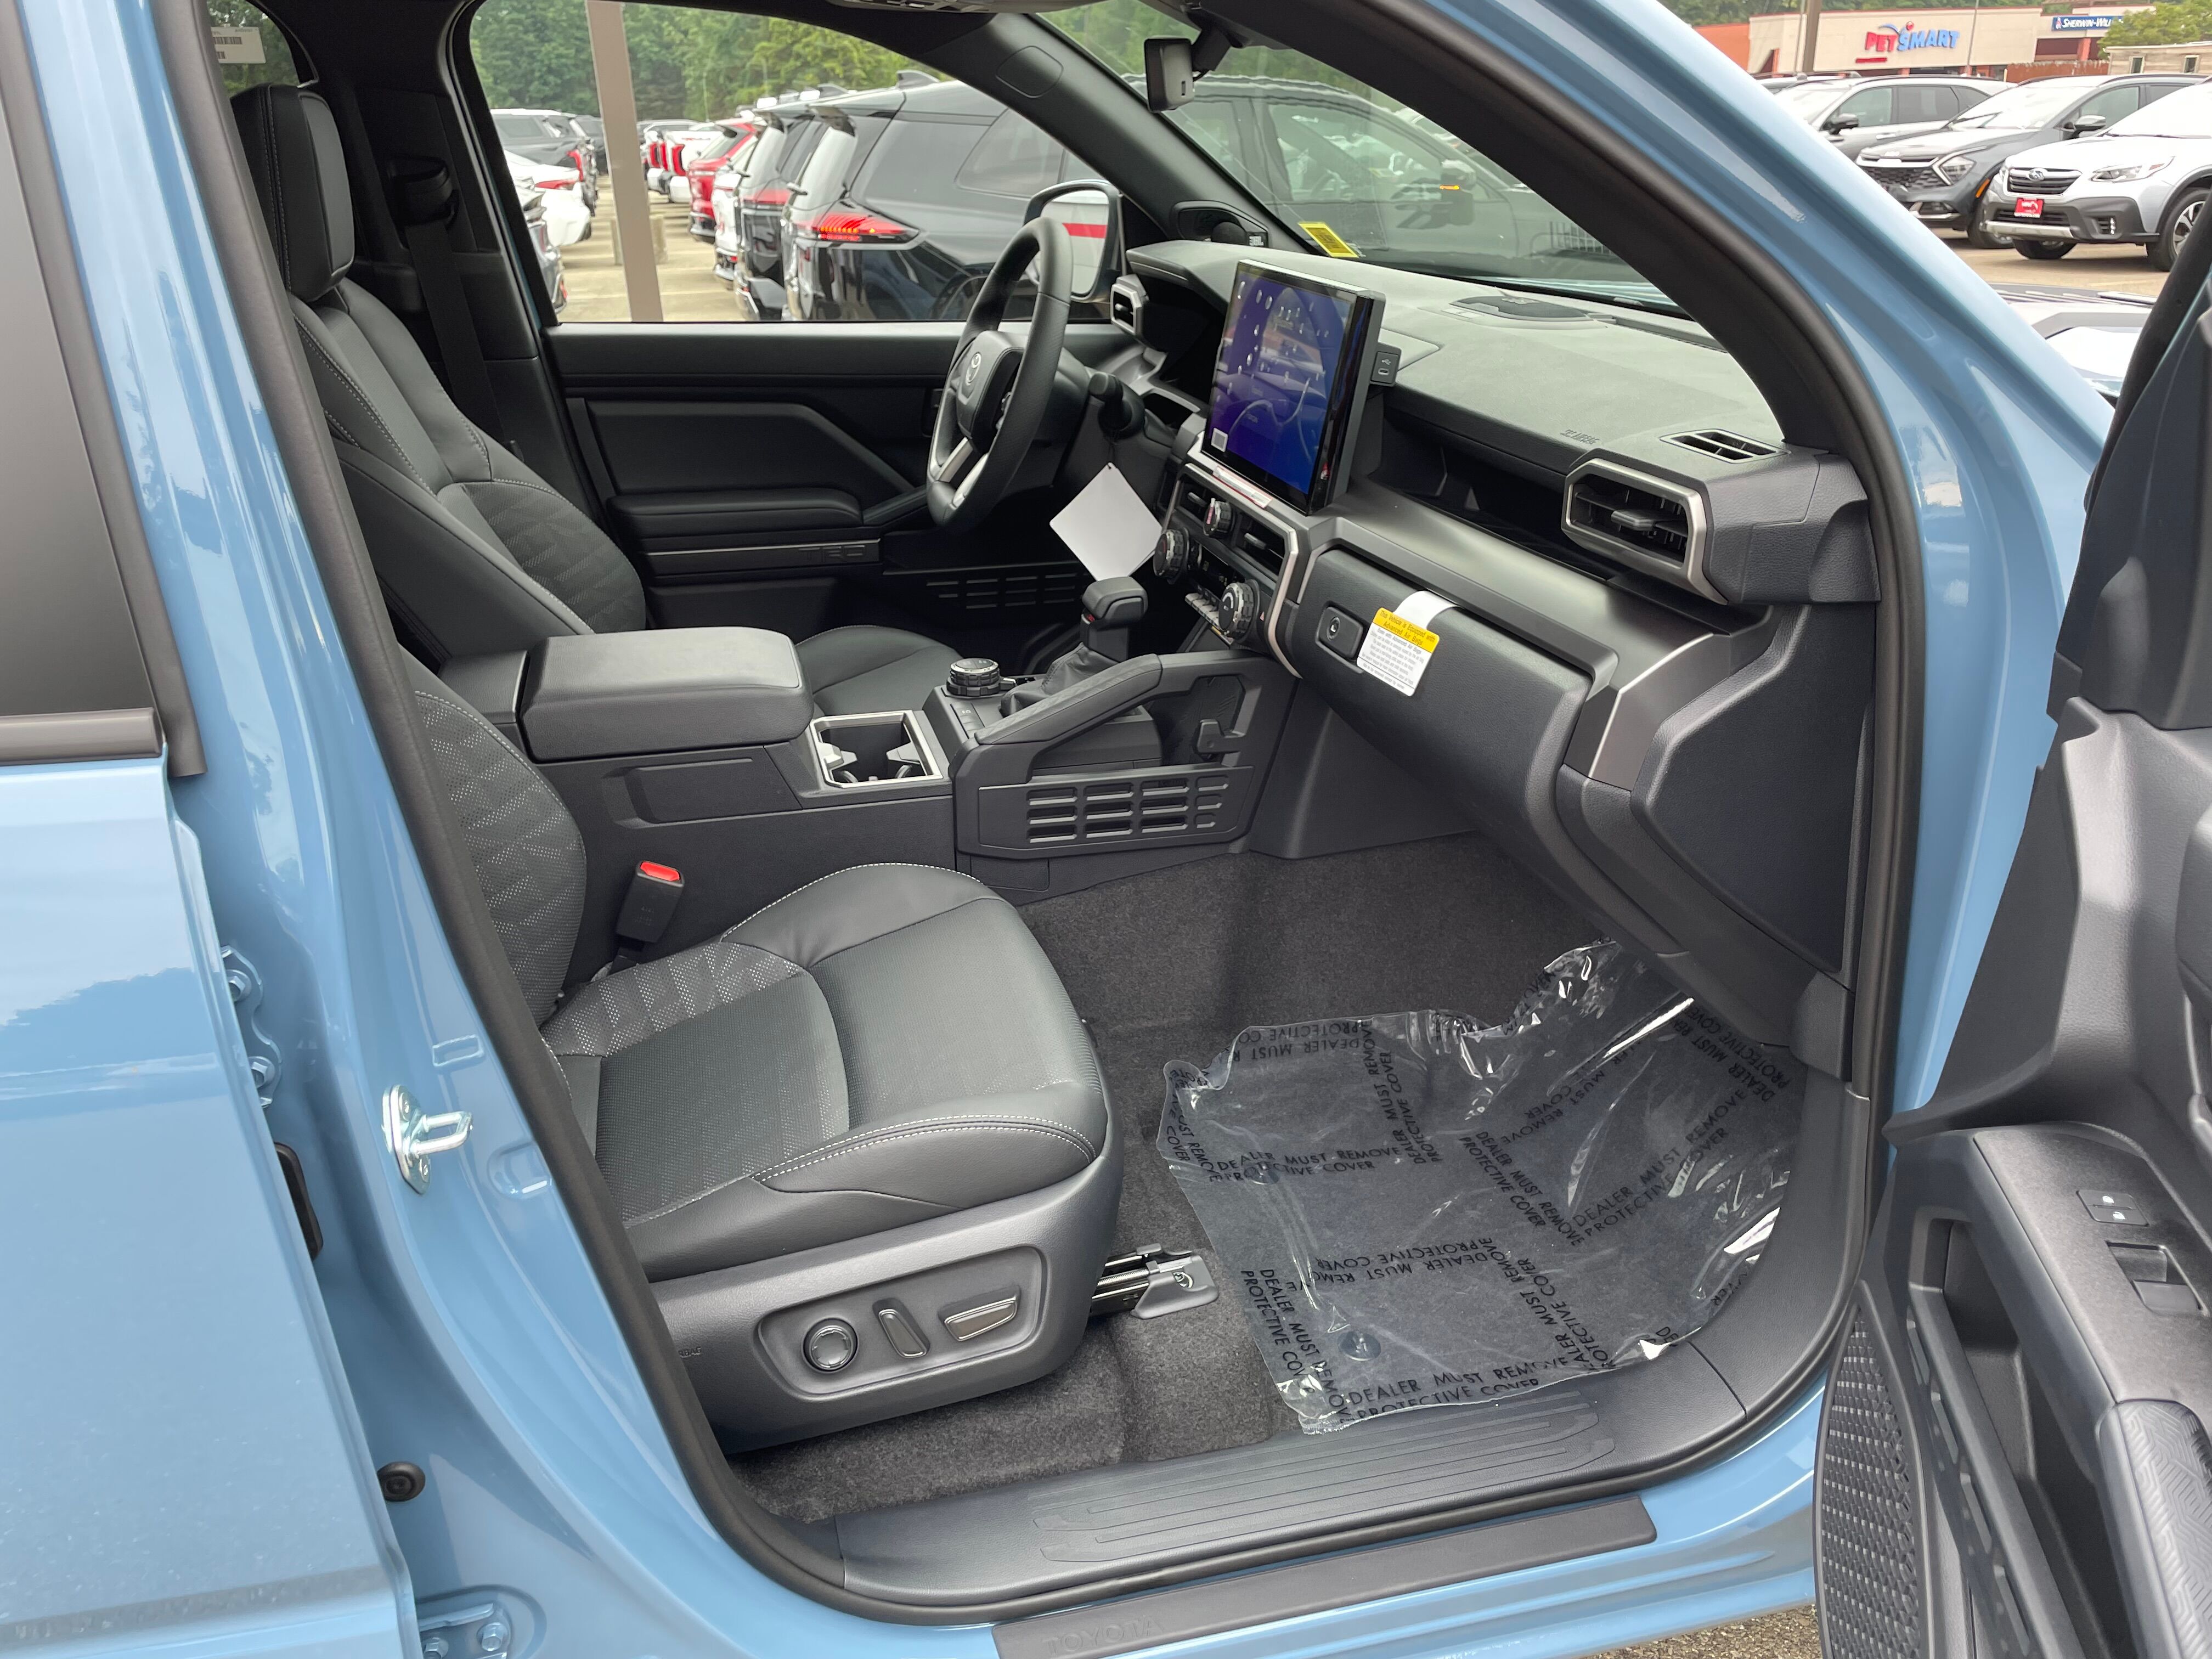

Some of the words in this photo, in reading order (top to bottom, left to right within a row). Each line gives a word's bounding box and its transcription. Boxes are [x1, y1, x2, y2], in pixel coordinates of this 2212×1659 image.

[1383, 621, 1403, 635] Advanced
[1412, 636, 1423, 646] Bags
[1389, 614, 1402, 625] Vehicle
[1407, 624, 1426, 637] Equipped
[1269, 1022, 1358, 1041] PROTECTIVE
[1688, 1007, 1721, 1034] COVE
[1251, 1043, 1292, 1060] MUST
[1304, 1038, 1359, 1053] DEALER
[1362, 1021, 1380, 1076] REMOVE
[1691, 1035, 1728, 1063] MUST
[1379, 1051, 1402, 1093] COVER
[1570, 1070, 1605, 1105] MUST
[1729, 1063, 1775, 1103] DEALER
[1374, 1083, 1398, 1120] MUST
[1524, 1085, 1571, 1119] COVER
[1166, 1125, 1190, 1161] COVER
[1397, 1098, 1443, 1163] PROTECTIVE
[1500, 1108, 1564, 1144] REMOVE
[1178, 1115, 1194, 1137] UST
[1187, 1143, 1223, 1182] REMOVE
[1217, 1151, 1275, 1171] DEALER
[1284, 1152, 1328, 1165] MUST
[1336, 1146, 1401, 1160] REMOVE
[1392, 1128, 1426, 1164] DEALER
[1573, 1186, 1633, 1228] DEALER
[1640, 1147, 1681, 1185] MUST
[1685, 1088, 1744, 1144] REMOVE
[1323, 1160, 1375, 1172] COVER
[1459, 1137, 1515, 1192] PROTECTIVE
[1510, 1195, 1546, 1226] COVER
[1476, 1131, 1513, 1166] DEALER
[1510, 1170, 1543, 1197] MUST
[1538, 1201, 1585, 1246] REMOVE
[1584, 1172, 1675, 1237] PROTECTIVE
[1315, 1256, 1370, 1271] COVER
[1378, 1240, 1479, 1263] PROTECTIVE
[1425, 1252, 1488, 1271] DEALER
[1479, 1237, 1525, 1283] REMOVE
[1287, 1271, 1355, 1291] REMOVE
[1367, 1263, 1413, 1280] MUST
[1260, 1269, 1295, 1313] DEALER
[1289, 1322, 1320, 1356] MUST
[1520, 1291, 1558, 1325] MUST
[1240, 1270, 1290, 1346] PROTECTIVE
[1282, 1351, 1316, 1394] COVR
[1550, 1301, 1616, 1369] ROTECTIVE
[1555, 1333, 1598, 1370] EALER
[1348, 1378, 1421, 1405] DEALER
[1432, 1372, 1483, 1388] MUST
[1493, 1357, 1568, 1380] REMOVE
[1358, 1386, 1476, 1419] PROTECTIVE
[1480, 1378, 1539, 1396] COVER
[1041, 1615, 1164, 1655] TOYOTA
